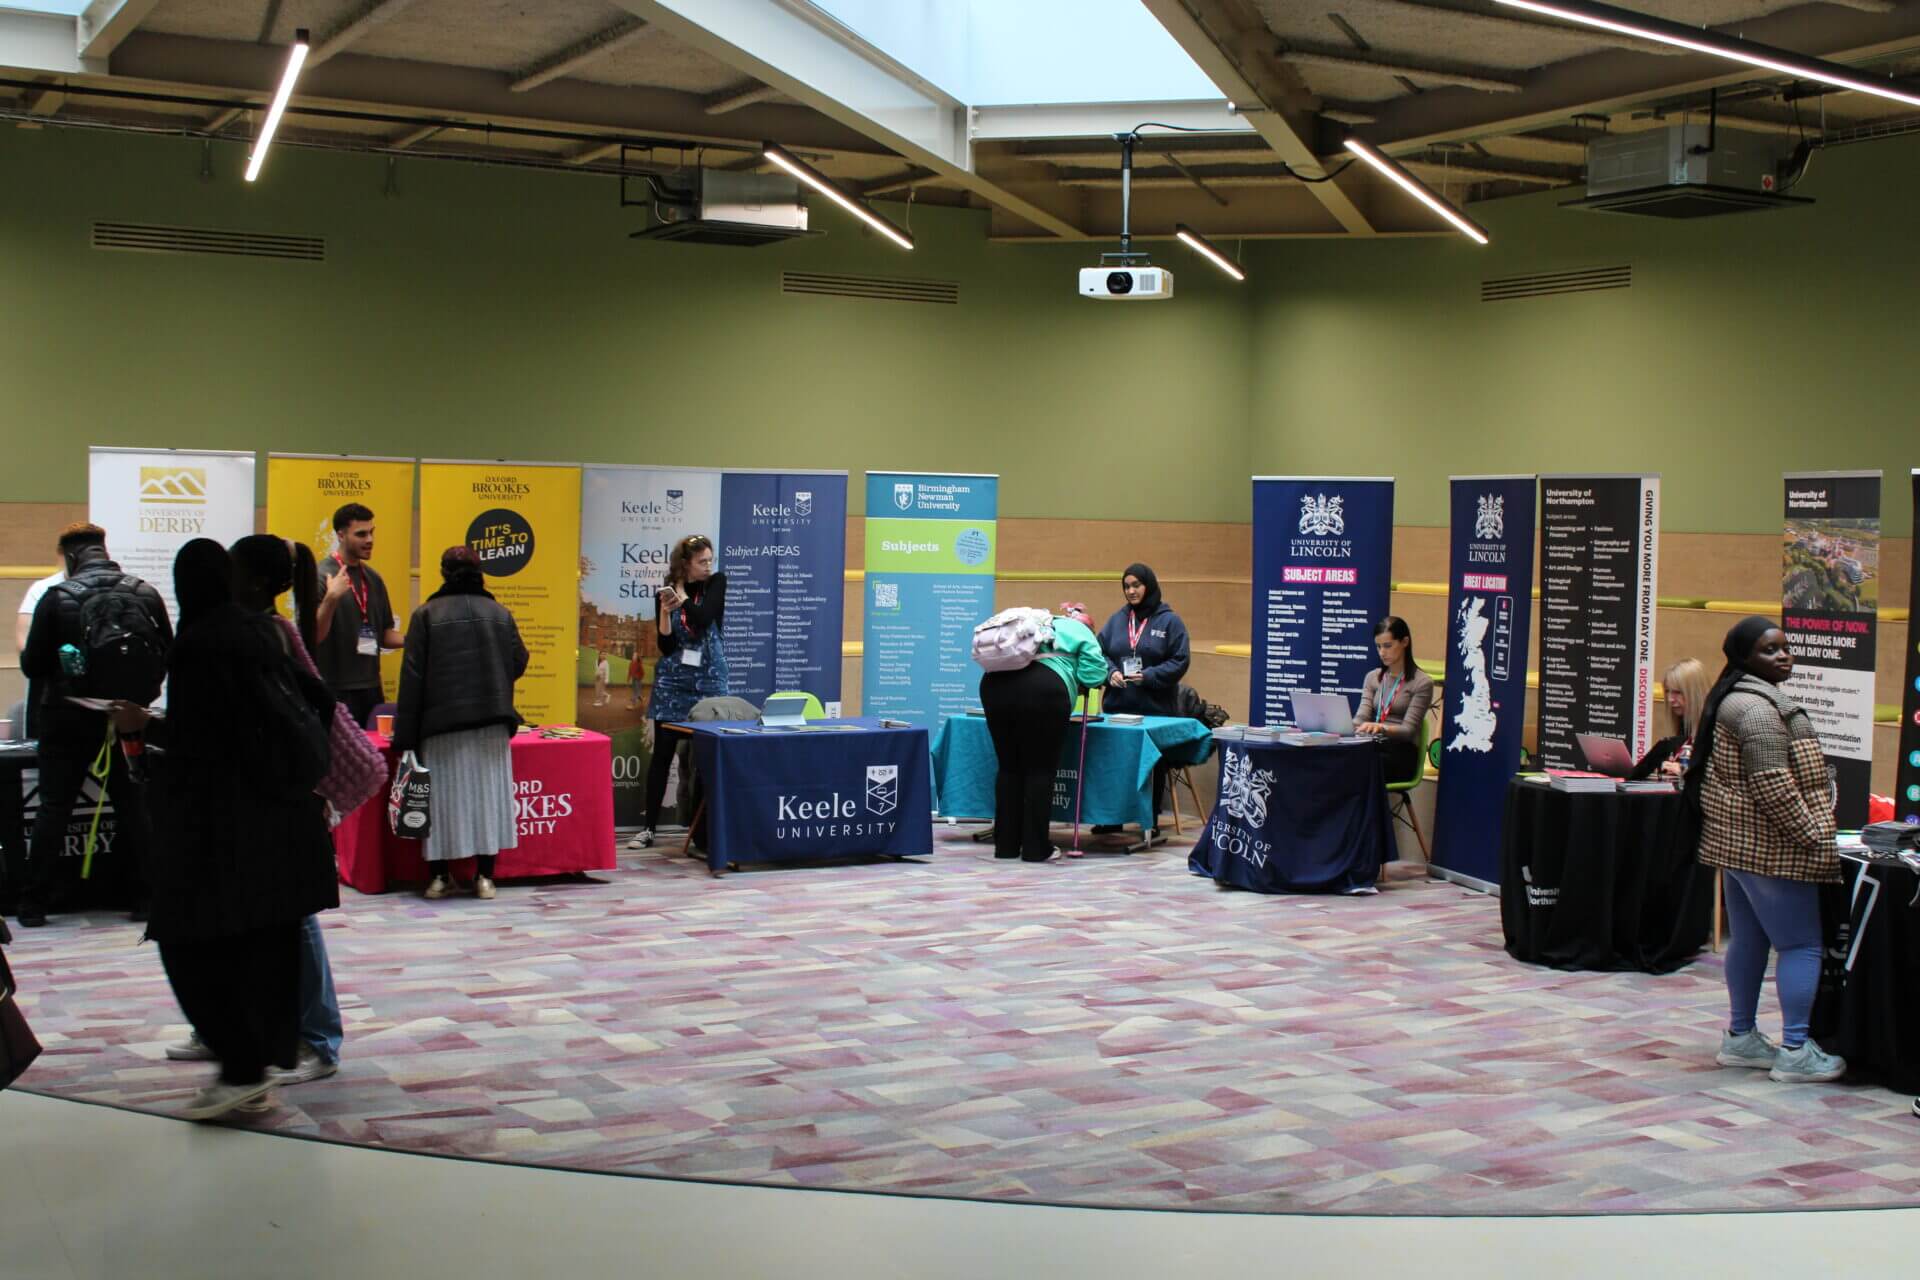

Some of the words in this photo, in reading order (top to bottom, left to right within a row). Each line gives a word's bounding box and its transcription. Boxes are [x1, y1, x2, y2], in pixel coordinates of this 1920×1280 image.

[317, 479, 371, 490] BROOKES
[472, 483, 530, 494] BROOKES
[918, 484, 970, 494] Birmingham
[918, 493, 953, 501] Newman
[1546, 489, 1582, 498] University
[1789, 490, 1817, 500] University
[1818, 490, 1826, 498] of
[622, 501, 661, 514] Keele
[918, 501, 960, 511] University
[1546, 498, 1594, 506] Northampton
[1645, 490, 1654, 526] GIVING
[1789, 500, 1828, 508] Northampton
[753, 504, 791, 516] Keele
[139, 517, 206, 533] DERBY
[485, 524, 511, 537] IT'S
[472, 536, 505, 551] TIME
[510, 532, 528, 545] TO
[1644, 529, 1653, 550] YOU
[480, 544, 525, 561] LEARN
[622, 543, 668, 564] Keel
[725, 546, 759, 560] Subject
[761, 546, 800, 556] AREAS
[882, 541, 939, 554] Subjects
[1291, 546, 1352, 558] LINCOLN
[1469, 551, 1506, 562] LINCOLN
[620, 566, 630, 578] is
[1642, 553, 1652, 582] MORE
[1284, 568, 1322, 581] SUBJECT
[1326, 570, 1354, 582] AREAS
[619, 581, 658, 598] star
[1464, 576, 1481, 588] GREAT
[1482, 576, 1506, 590] LOCATION
[1642, 585, 1650, 614] FROM
[1641, 618, 1650, 638] DAY
[1786, 617, 1800, 628] THE
[1802, 618, 1830, 631] POWER
[1832, 620, 1844, 632] OF
[1845, 620, 1869, 633] NOW.
[1786, 632, 1804, 644] NOW
[1805, 634, 1832, 646] MEANS
[1832, 636, 1856, 648] MORE
[1640, 640, 1648, 664] ONE.
[1788, 645, 1806, 656] ROM
[1807, 646, 1822, 658] DAY
[1822, 647, 1842, 660] ONE.
[1638, 668, 1648, 717] DISCOVER
[1788, 695, 1804, 703] nded
[1805, 696, 1820, 706] study
[1820, 698, 1834, 707] trips
[1638, 720, 1646, 740] THE
[612, 756, 640, 779] 00
[409, 782, 430, 793] M&S
[778, 793, 856, 820] Keele
[776, 822, 896, 839] UNIVERSITY
[1254, 840, 1272, 852] OF
